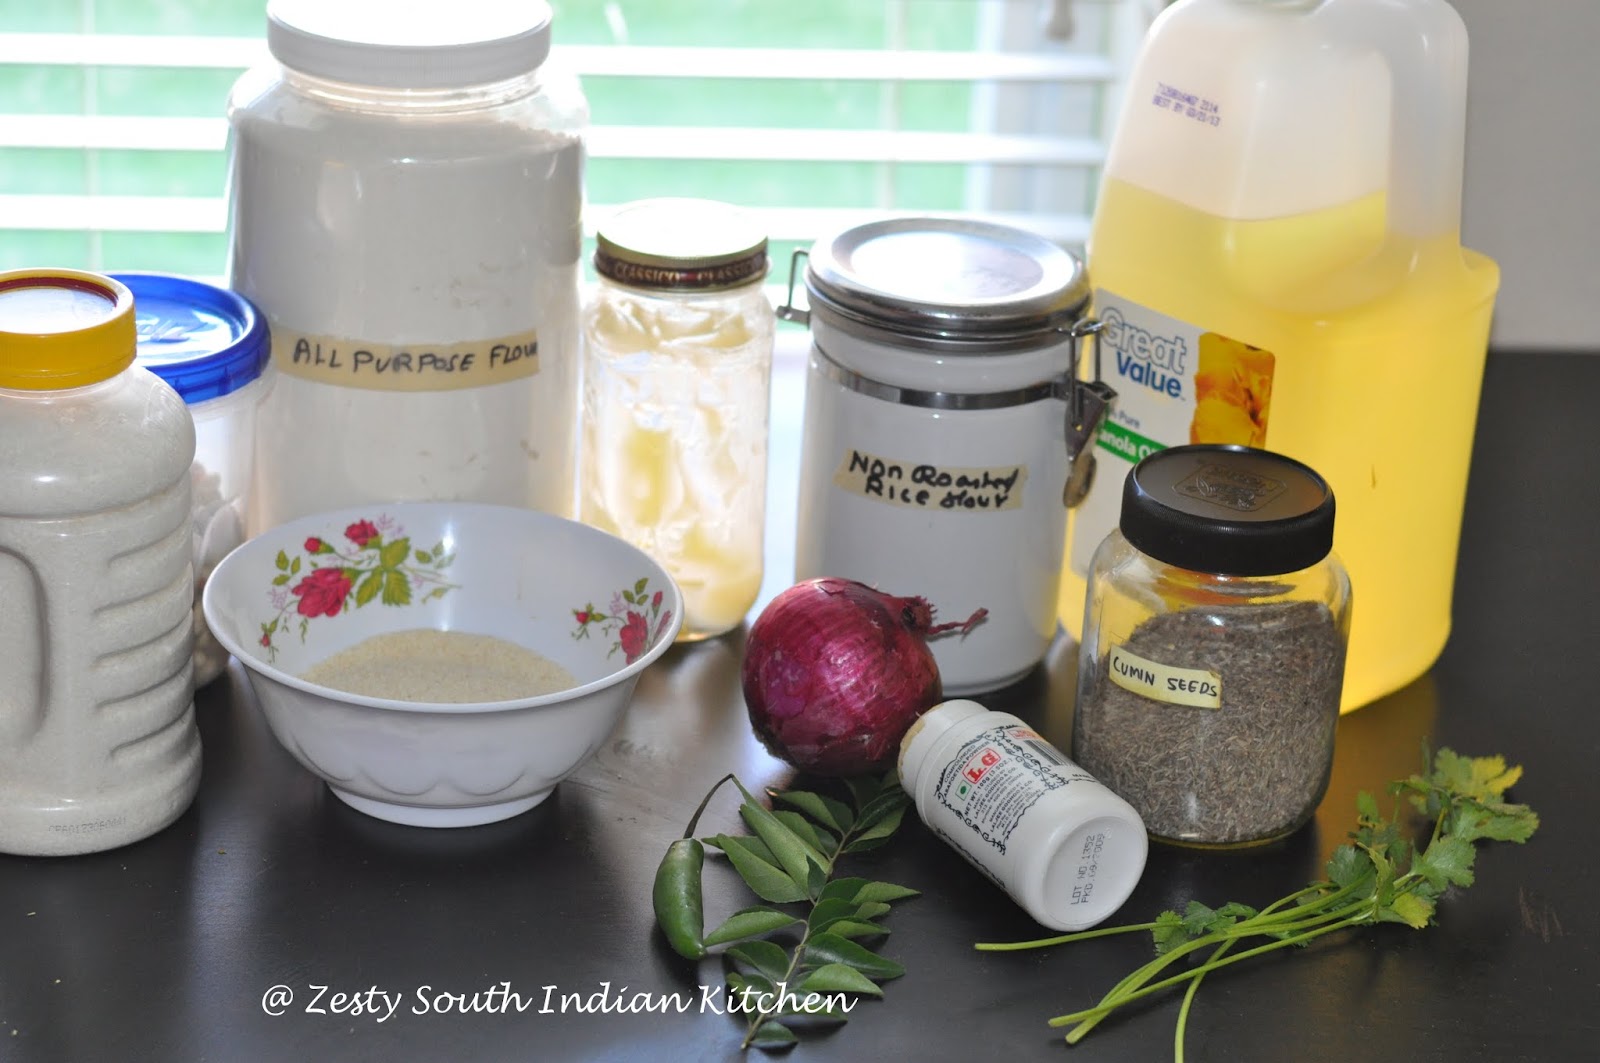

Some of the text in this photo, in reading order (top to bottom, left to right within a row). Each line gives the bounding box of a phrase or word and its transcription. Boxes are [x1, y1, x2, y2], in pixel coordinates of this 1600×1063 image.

[293, 338, 342, 368] ALL
[353, 350, 475, 373] PURPOSE
[1100, 307, 1187, 375] Great
[1116, 351, 1182, 398] Value
[1099, 429, 1137, 457] anola
[1113, 656, 1218, 697] CUMIN SEEDS
[944, 744, 975, 782] COMPOUNDED
[965, 740, 989, 761] POWDER
[1070, 885, 1082, 905] LOT
